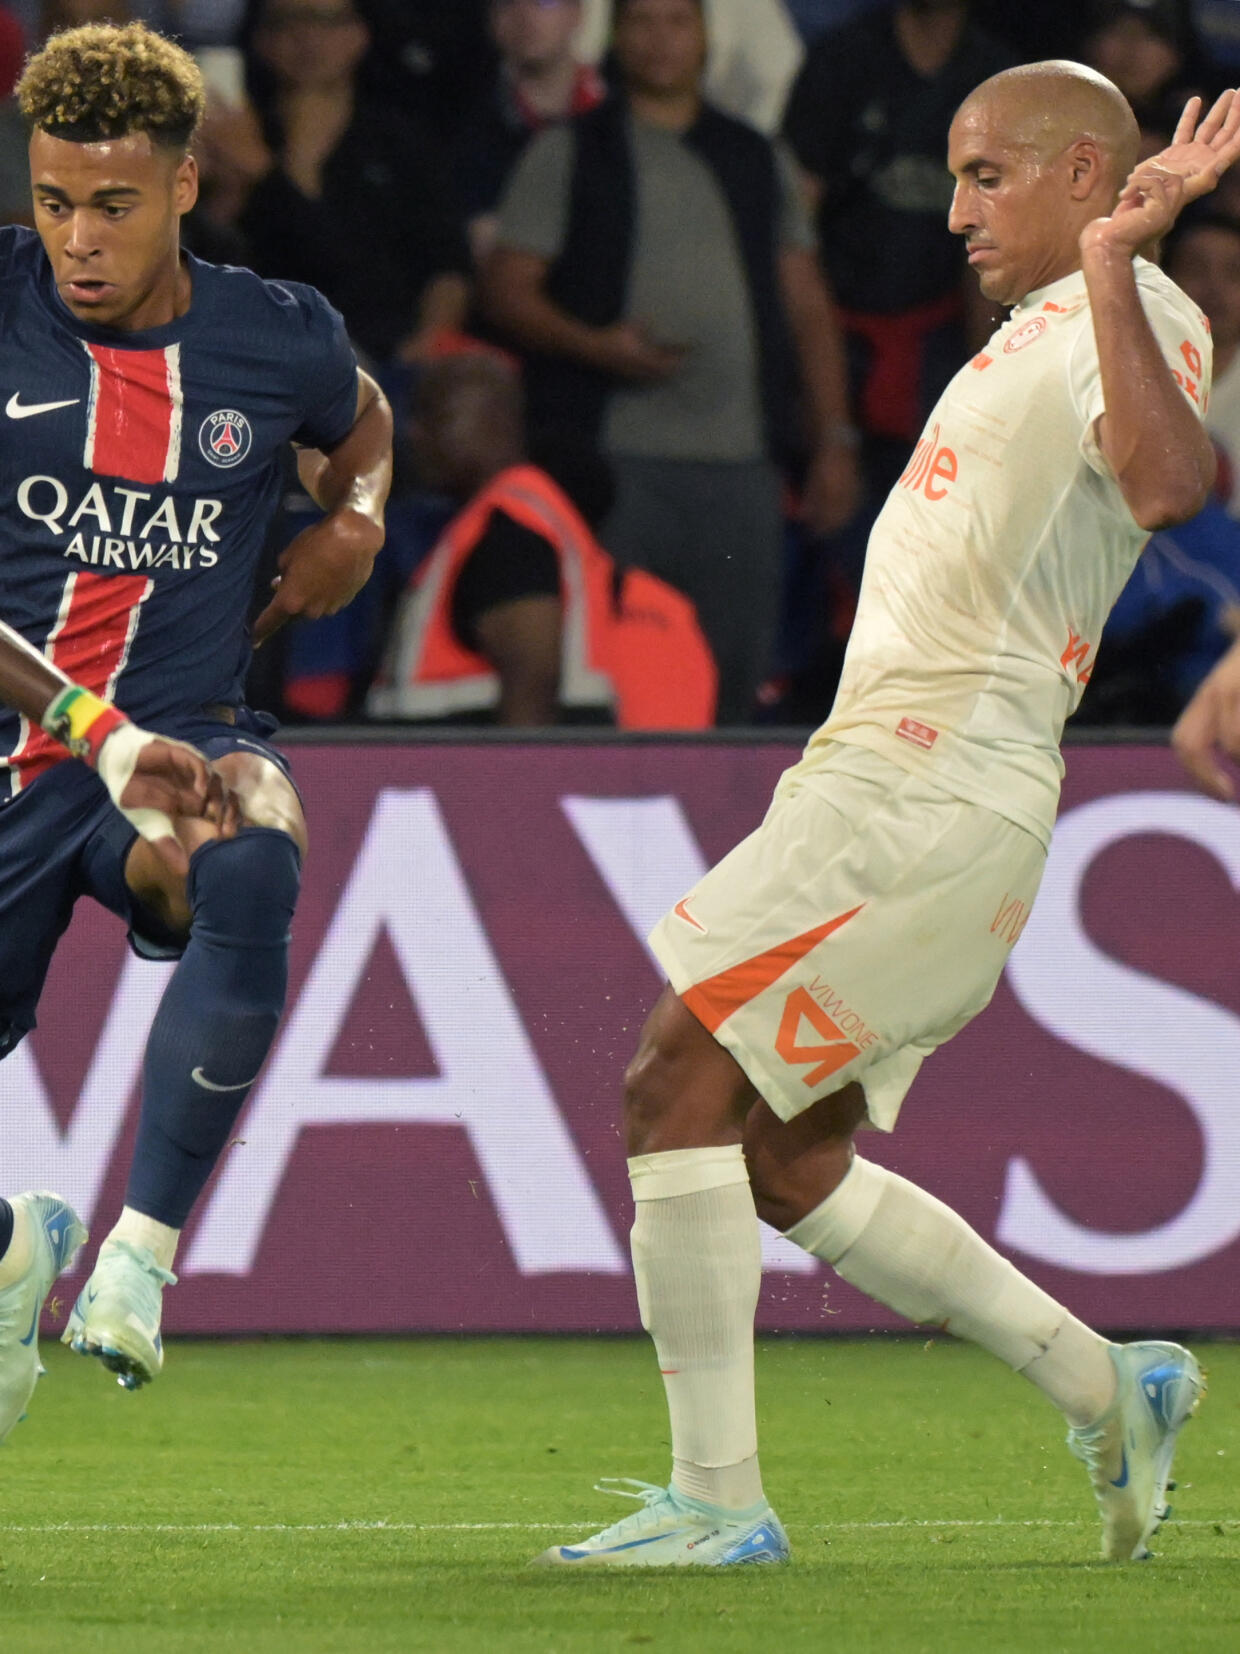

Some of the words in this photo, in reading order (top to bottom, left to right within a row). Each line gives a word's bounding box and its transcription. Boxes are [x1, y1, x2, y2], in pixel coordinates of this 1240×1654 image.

[210, 412, 245, 428] PARIS
[17, 475, 223, 543] QATAR
[63, 533, 218, 570] AIRWAYS
[809, 974, 879, 1049] VIWONE
